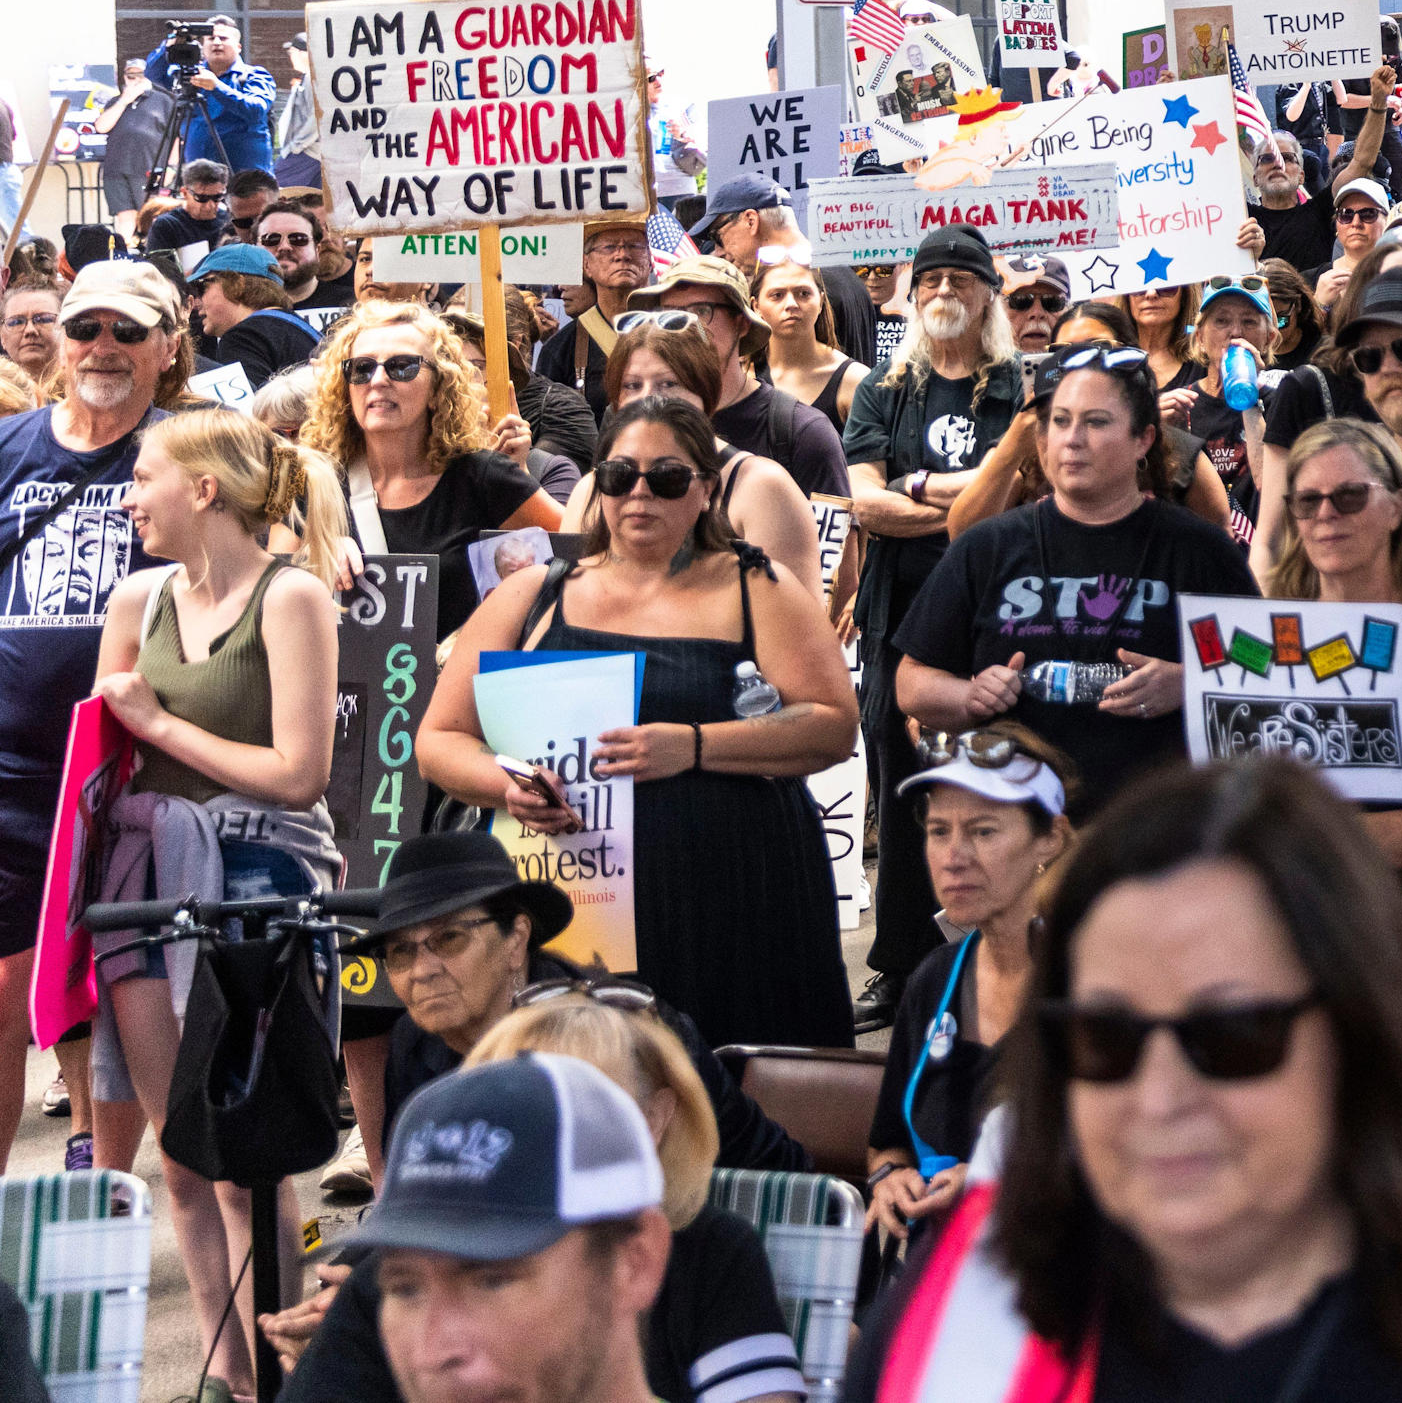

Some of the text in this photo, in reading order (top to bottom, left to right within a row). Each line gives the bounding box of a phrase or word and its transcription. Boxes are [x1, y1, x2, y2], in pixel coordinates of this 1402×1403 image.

[1001, 3, 1055, 21] DEPORT
[1263, 11, 1345, 36] TRUMP
[325, 18, 334, 58] I
[349, 11, 405, 57] AM
[418, 10, 444, 54] A
[1002, 19, 1056, 37] LATINA
[1004, 35, 1058, 52] BADDIES
[1247, 47, 1371, 73] ANTOINETTE
[331, 51, 599, 105] OF FREEDOM
[749, 96, 804, 127] WE
[916, 97, 942, 111] MUSK
[330, 108, 387, 135] AND
[366, 98, 627, 167] THE AMERICAN
[1086, 114, 1153, 152] Being
[739, 124, 812, 165] ARE
[756, 161, 811, 193] LL
[1116, 150, 1195, 190] iversity
[346, 165, 628, 219] WAY OF LIFE
[824, 201, 875, 215] MY BIG
[920, 198, 1089, 230] MAGA TANK
[823, 218, 894, 234] BEAUTIFUL
[1056, 228, 1098, 248] ME!
[401, 233, 548, 257] ATTENON!
[853, 248, 899, 260] HAPPY
[1210, 447, 1236, 458] LOVE
[13, 484, 114, 508] LOCK IM
[336, 562, 428, 629] ST
[20, 615, 99, 627] AMERICA SMILE
